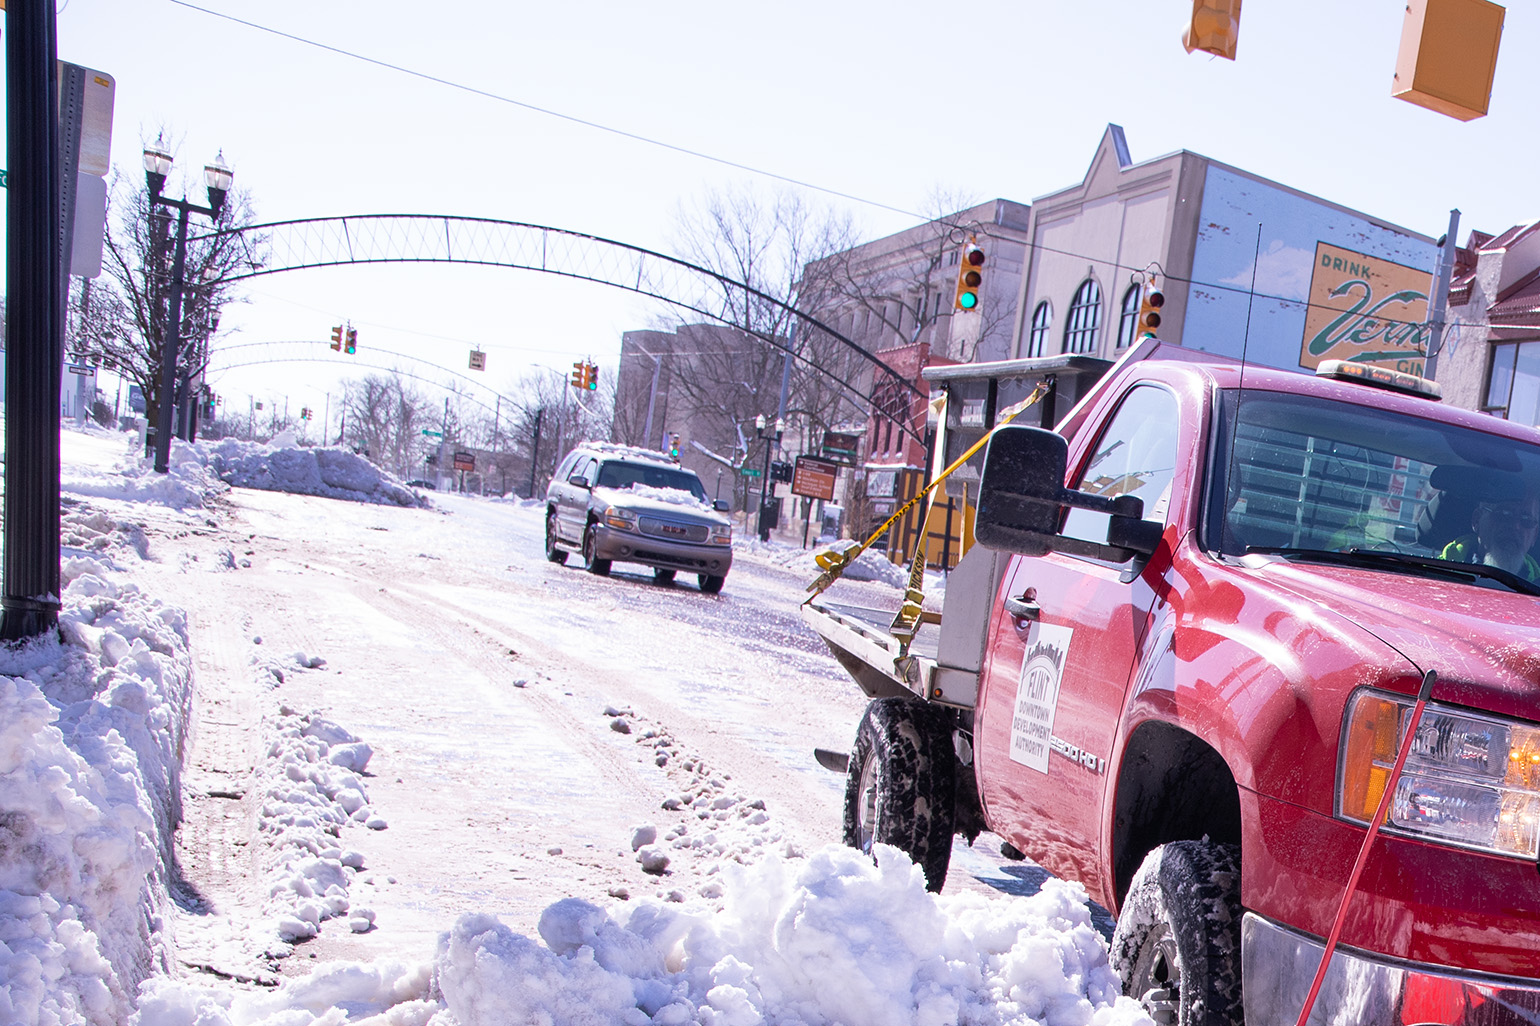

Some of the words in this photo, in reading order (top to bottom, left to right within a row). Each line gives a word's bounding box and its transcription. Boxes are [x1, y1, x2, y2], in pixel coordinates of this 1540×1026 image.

[1322, 254, 1371, 280] DRINK
[1027, 670, 1050, 701] FLINT
[1018, 700, 1050, 722] DOWNTOWN
[1013, 716, 1050, 741] DEVELOPMENT
[1015, 736, 1045, 758] AUTHORITY
